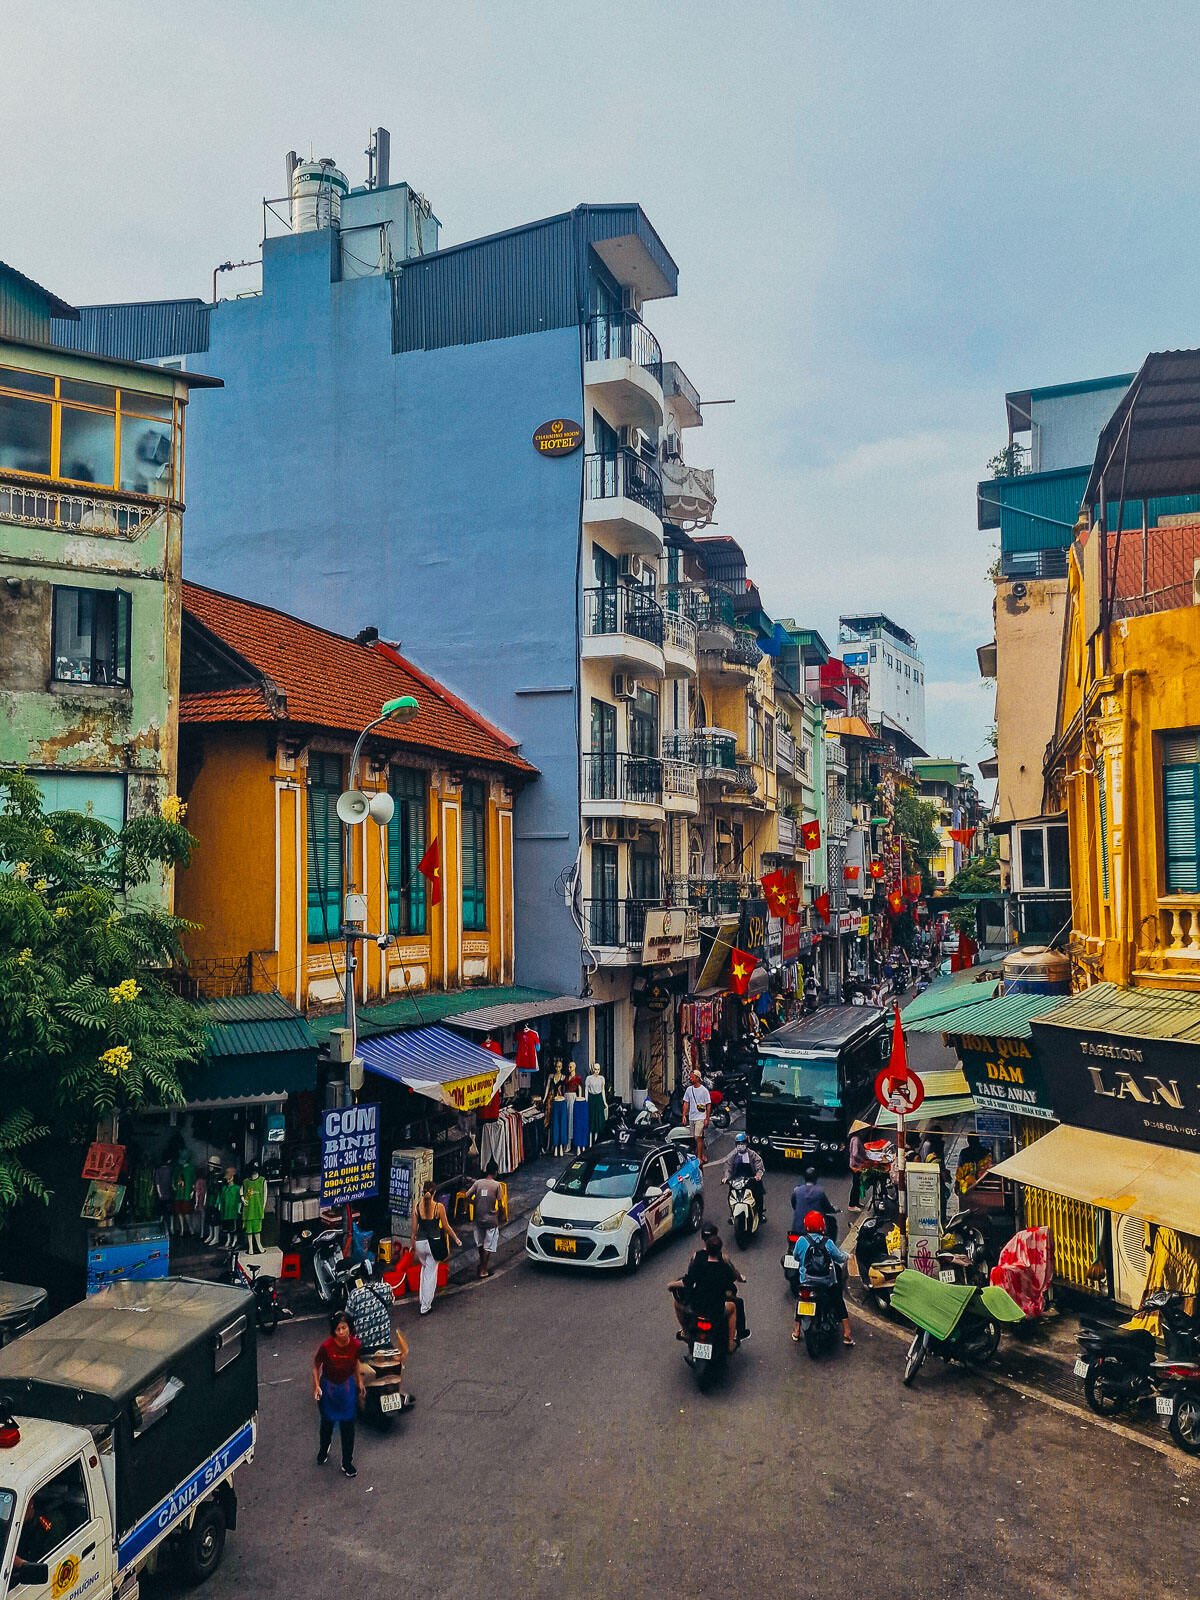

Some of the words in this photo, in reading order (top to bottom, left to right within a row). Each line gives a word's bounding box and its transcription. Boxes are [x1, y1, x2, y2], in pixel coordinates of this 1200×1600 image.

[540, 437, 575, 450] HOTEL
[748, 916, 765, 949] SPA
[1080, 1042, 1144, 1063] FASHION
[986, 1058, 1024, 1084] DẦM
[976, 1082, 1007, 1098] TAKE
[1007, 1087, 1038, 1104] AWAY
[1088, 1066, 1185, 1109] LAN
[325, 1106, 376, 1137] CƠM
[325, 1133, 376, 1154] BÌNH
[323, 1153, 338, 1169] 30K
[343, 1149, 358, 1166] 35K
[362, 1145, 377, 1161] 45K
[324, 1170, 339, 1179] 12A
[323, 1188, 341, 1198] SHIP
[158, 1481, 198, 1528] CẢNH
[204, 1450, 230, 1485] SÁT
